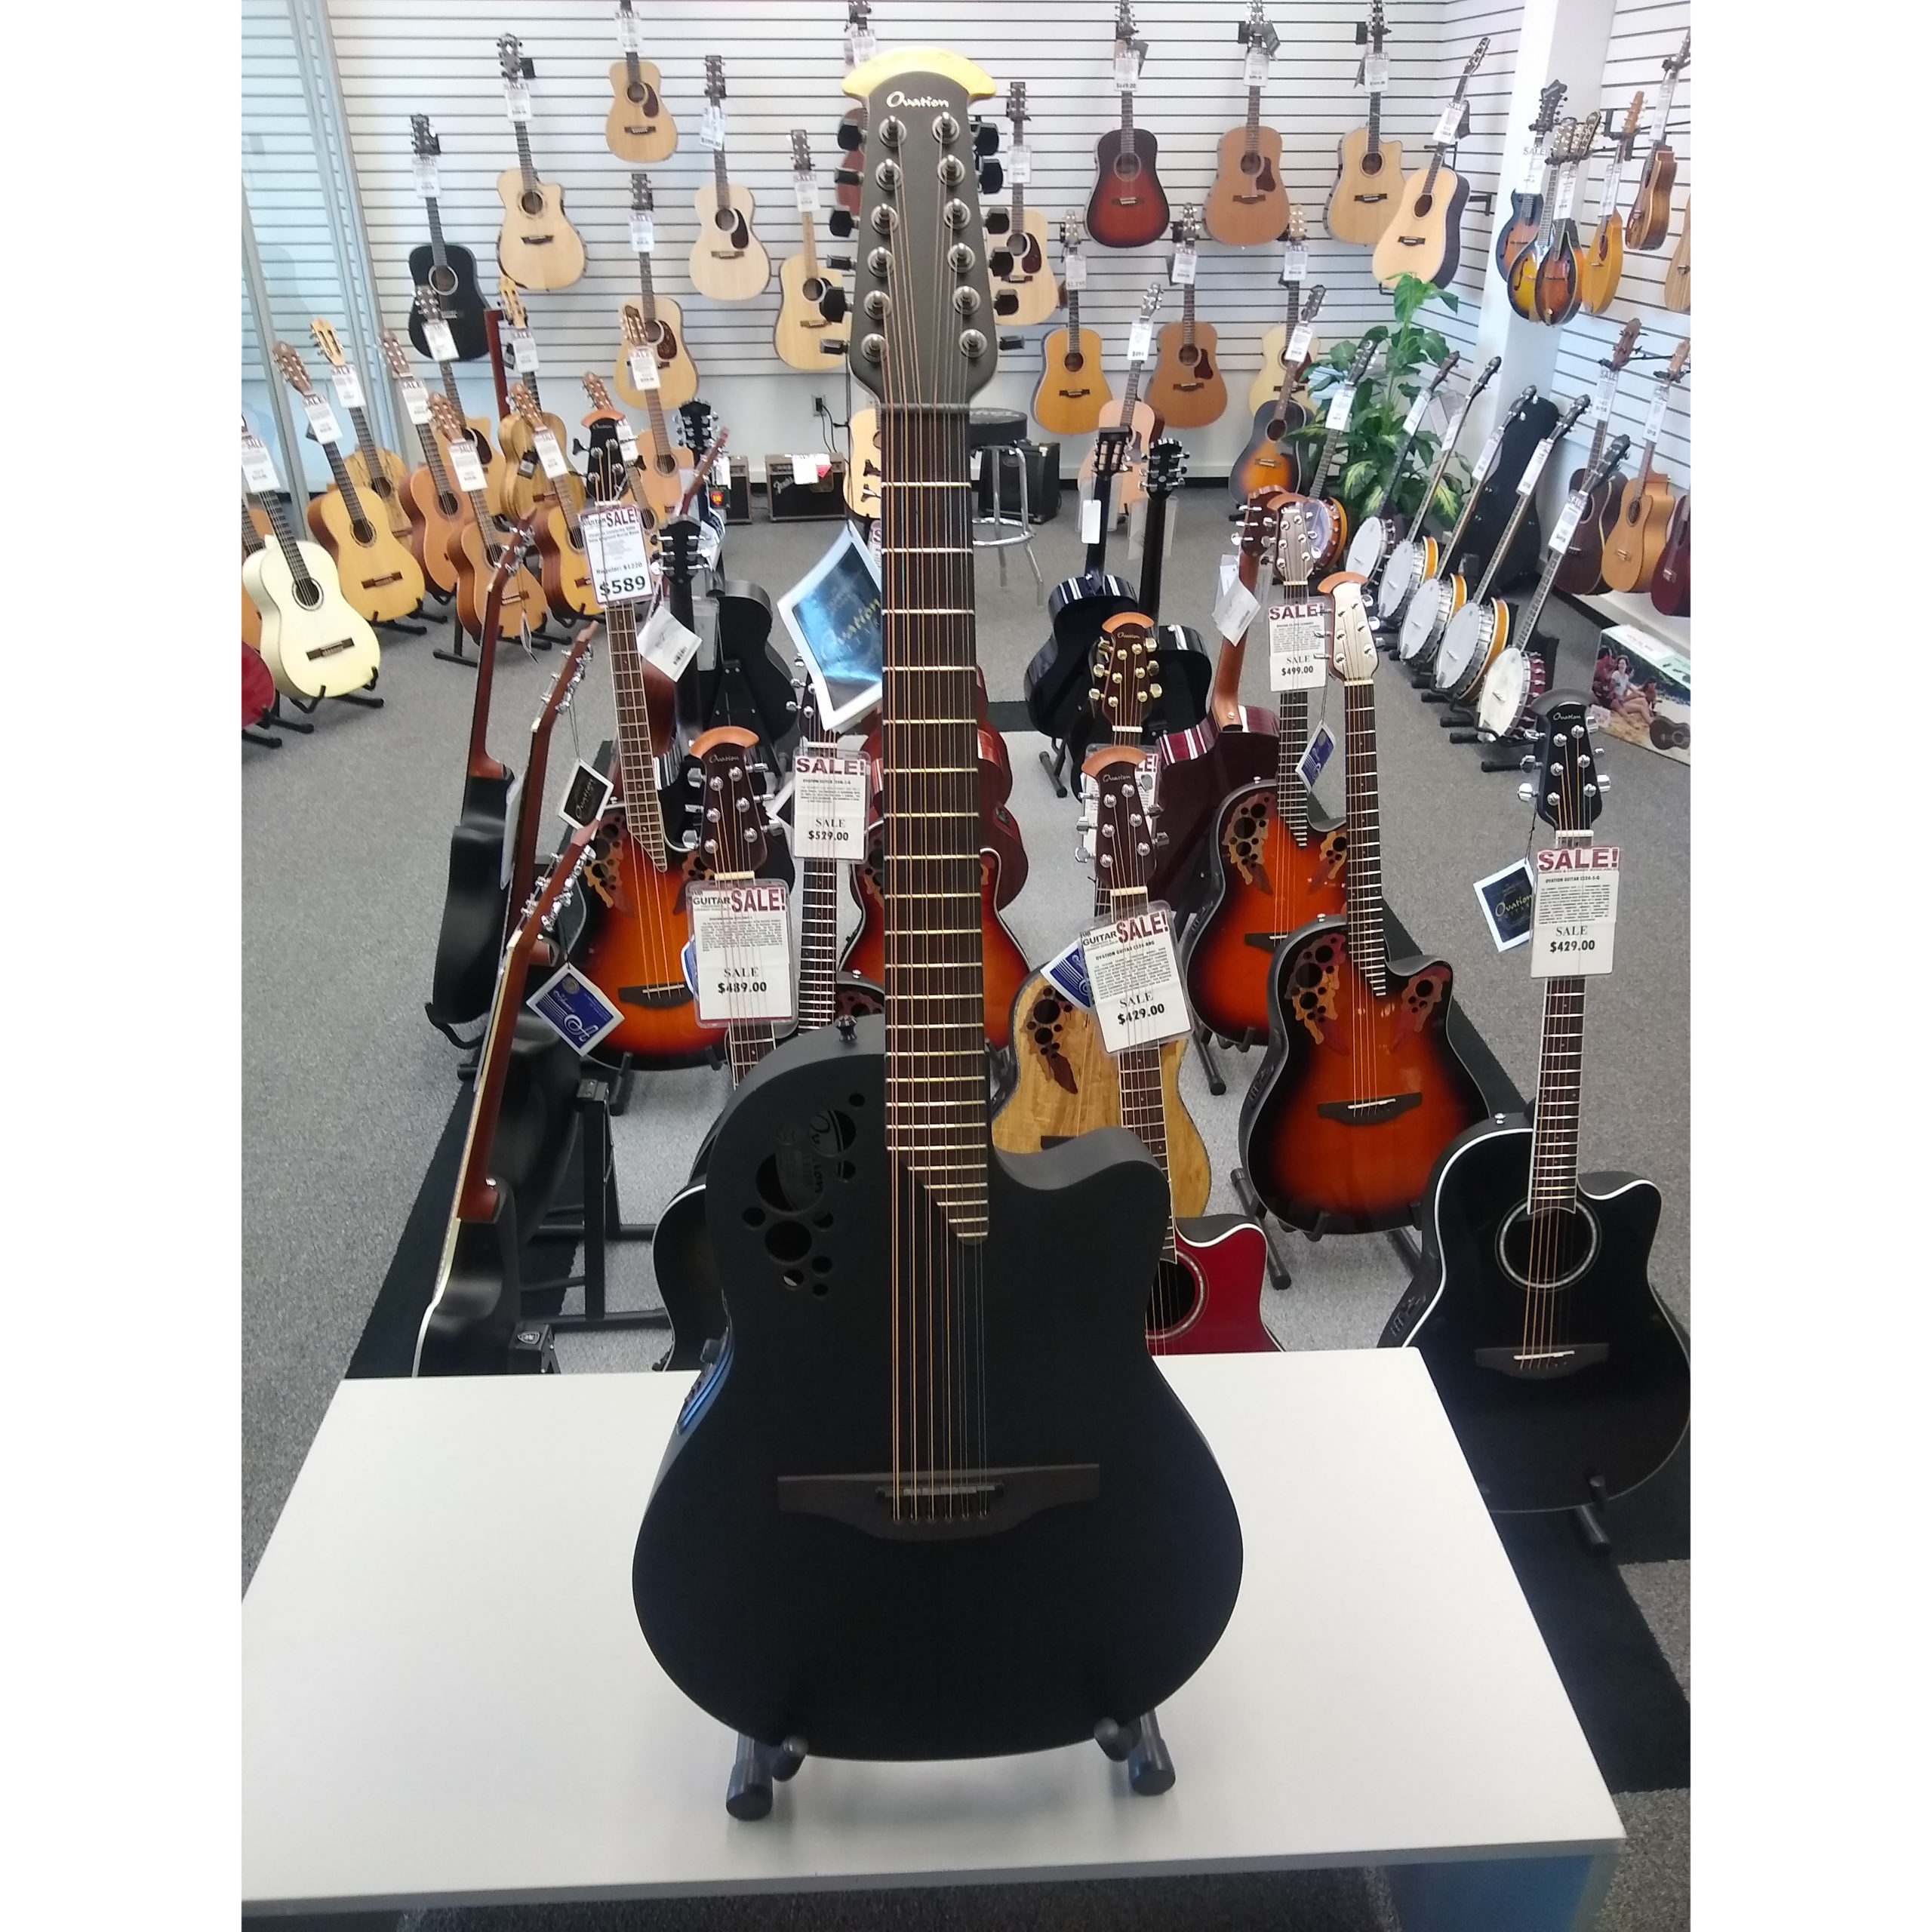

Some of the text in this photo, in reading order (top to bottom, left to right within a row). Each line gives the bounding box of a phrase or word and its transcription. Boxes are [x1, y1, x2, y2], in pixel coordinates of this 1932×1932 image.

[886, 91, 949, 108] Ovation
[606, 508, 640, 528] SALE!
[599, 575, 646, 596] $589
[1269, 604, 1324, 620] SALE!
[1286, 655, 1310, 664] SALE
[1281, 666, 1314, 676] $499.00
[1552, 712, 1581, 721] Ovation
[709, 753, 740, 764] Ovation
[796, 758, 865, 776] SALE!
[1103, 774, 1131, 783] Ovation
[815, 817, 846, 829] SALE
[808, 830, 849, 841] $529.00
[1538, 848, 1619, 871] SALE!
[693, 888, 786, 912] GUITAR SALE!
[1495, 894, 1533, 918] Ovation
[1083, 931, 1117, 946] GUITAR
[1117, 911, 1170, 944] SALE!
[1555, 925, 1588, 937] SALE
[1550, 940, 1595, 953] $429.00
[723, 968, 759, 978] SALE
[718, 982, 768, 994] $489.00
[1119, 991, 1154, 1009] SALE
[1117, 1003, 1165, 1026] $429.00
